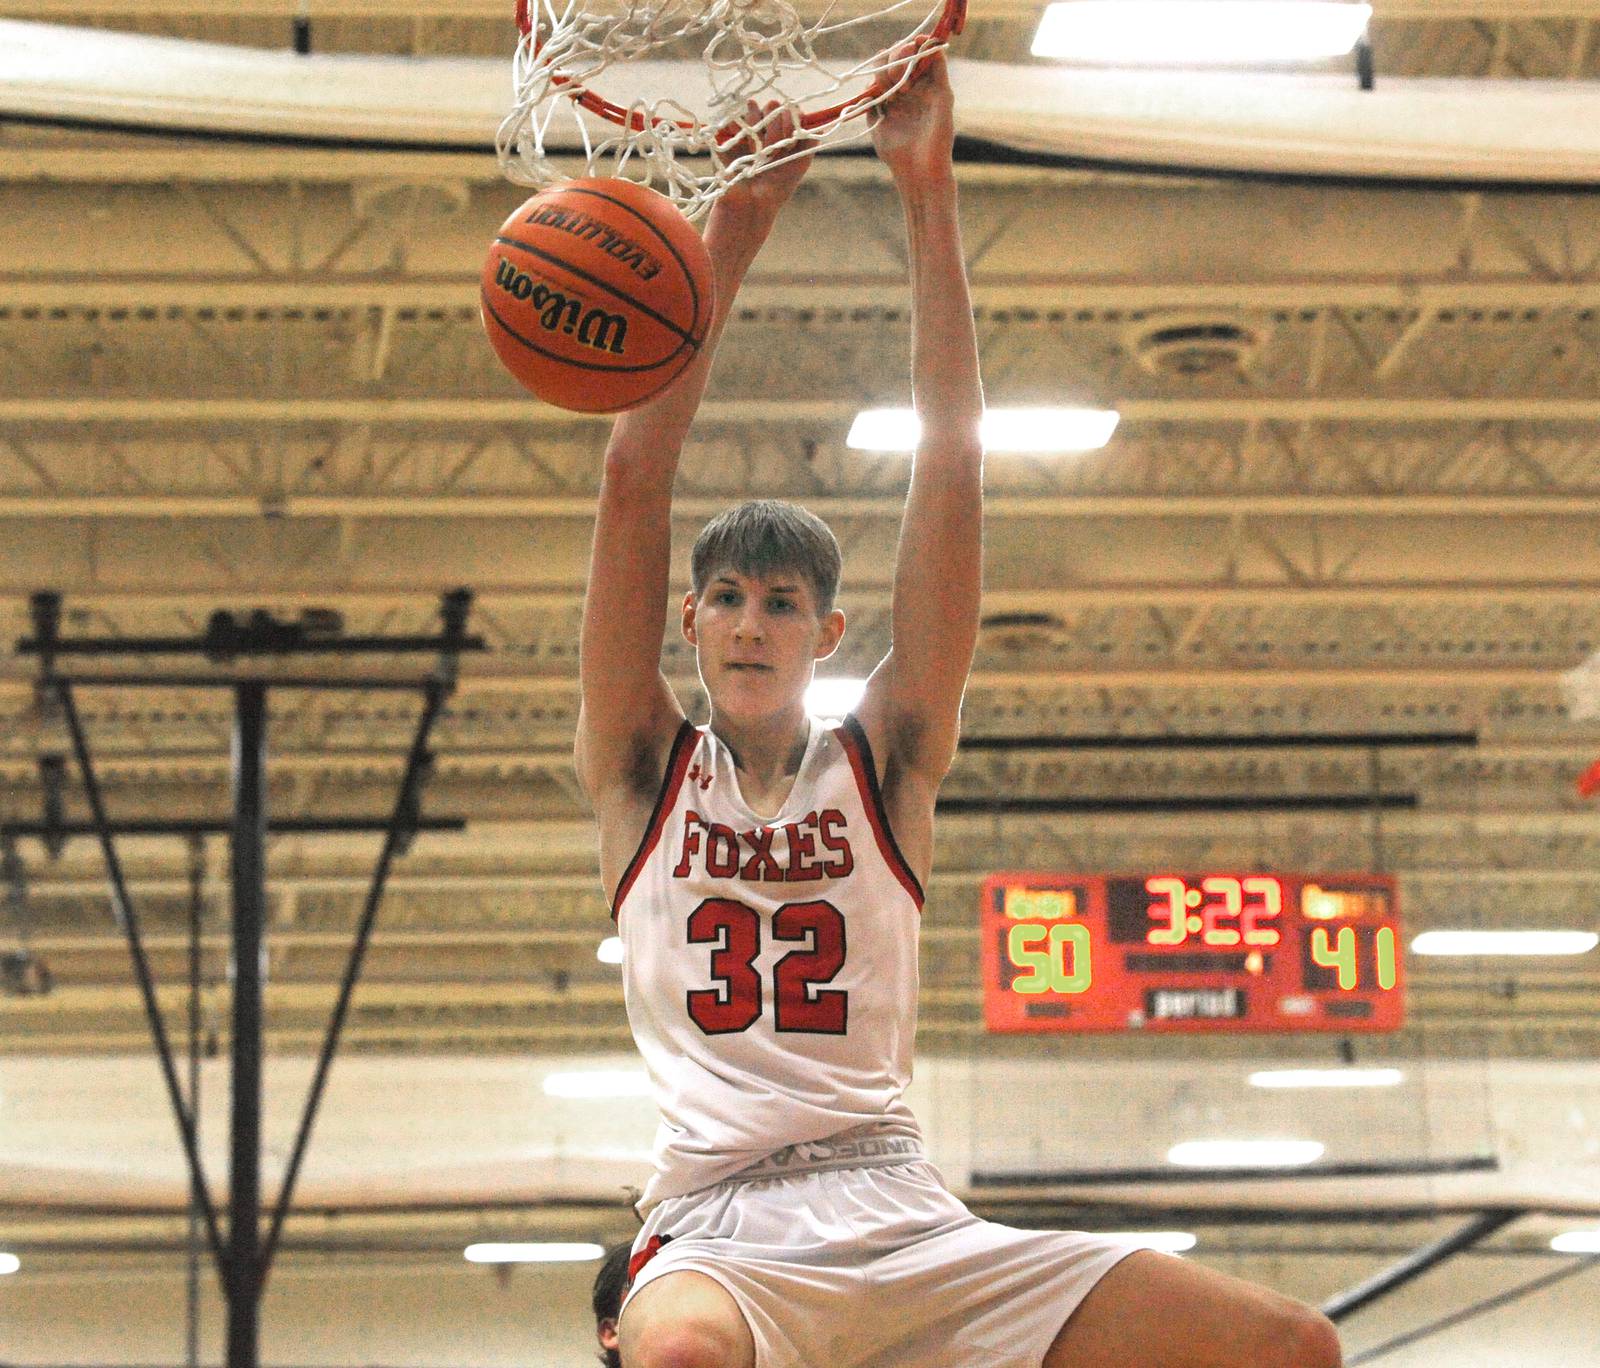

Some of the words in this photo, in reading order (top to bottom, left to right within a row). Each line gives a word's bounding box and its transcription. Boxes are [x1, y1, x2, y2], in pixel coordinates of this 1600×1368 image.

[526, 204, 662, 281] EVOLUTION
[495, 257, 628, 354] Wilson
[672, 808, 854, 882] FOXES
[1144, 877, 1281, 945] 3:22
[686, 897, 848, 1036] 32
[1008, 924, 1092, 993] 50
[1312, 927, 1397, 990] 41
